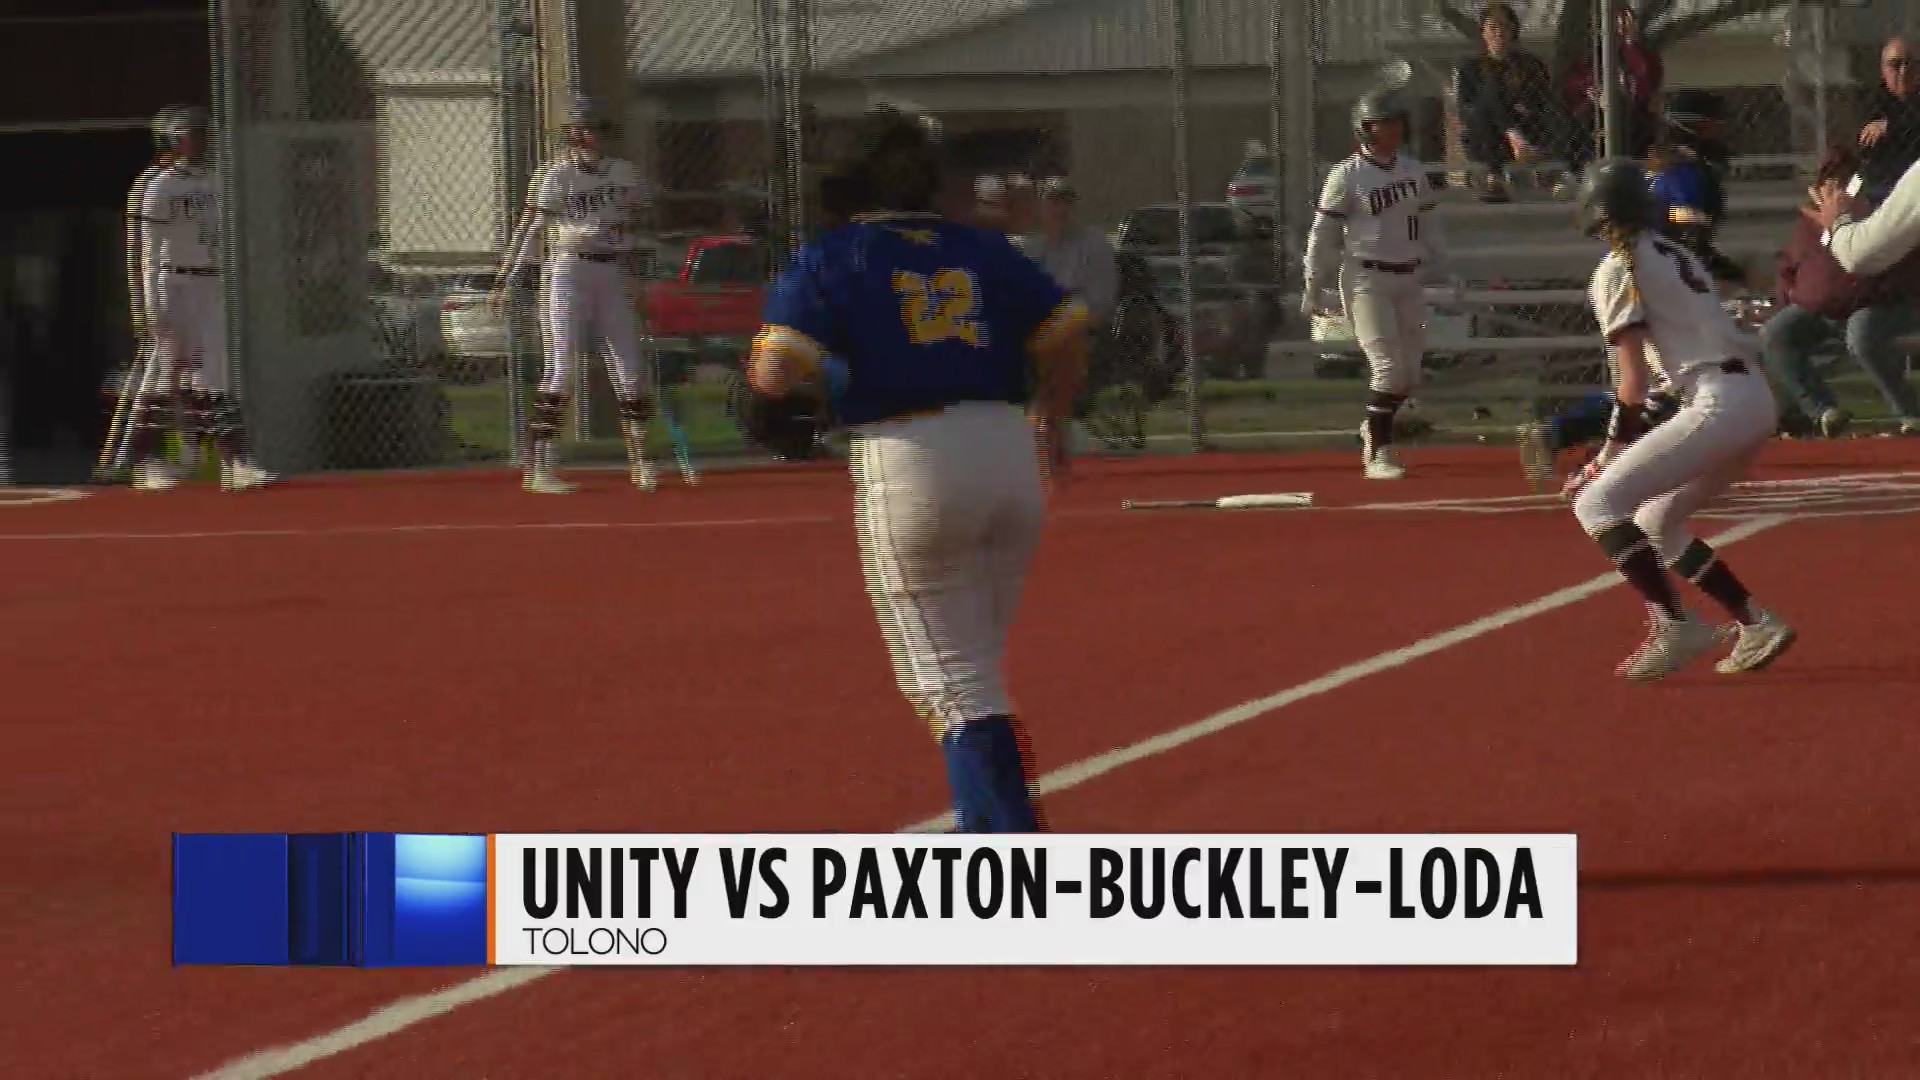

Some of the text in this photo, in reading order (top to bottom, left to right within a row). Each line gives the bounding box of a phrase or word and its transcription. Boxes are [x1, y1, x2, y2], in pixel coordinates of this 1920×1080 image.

[1369, 178, 1419, 215] UNITY
[1406, 215, 1419, 241] 11
[891, 266, 990, 348] 22
